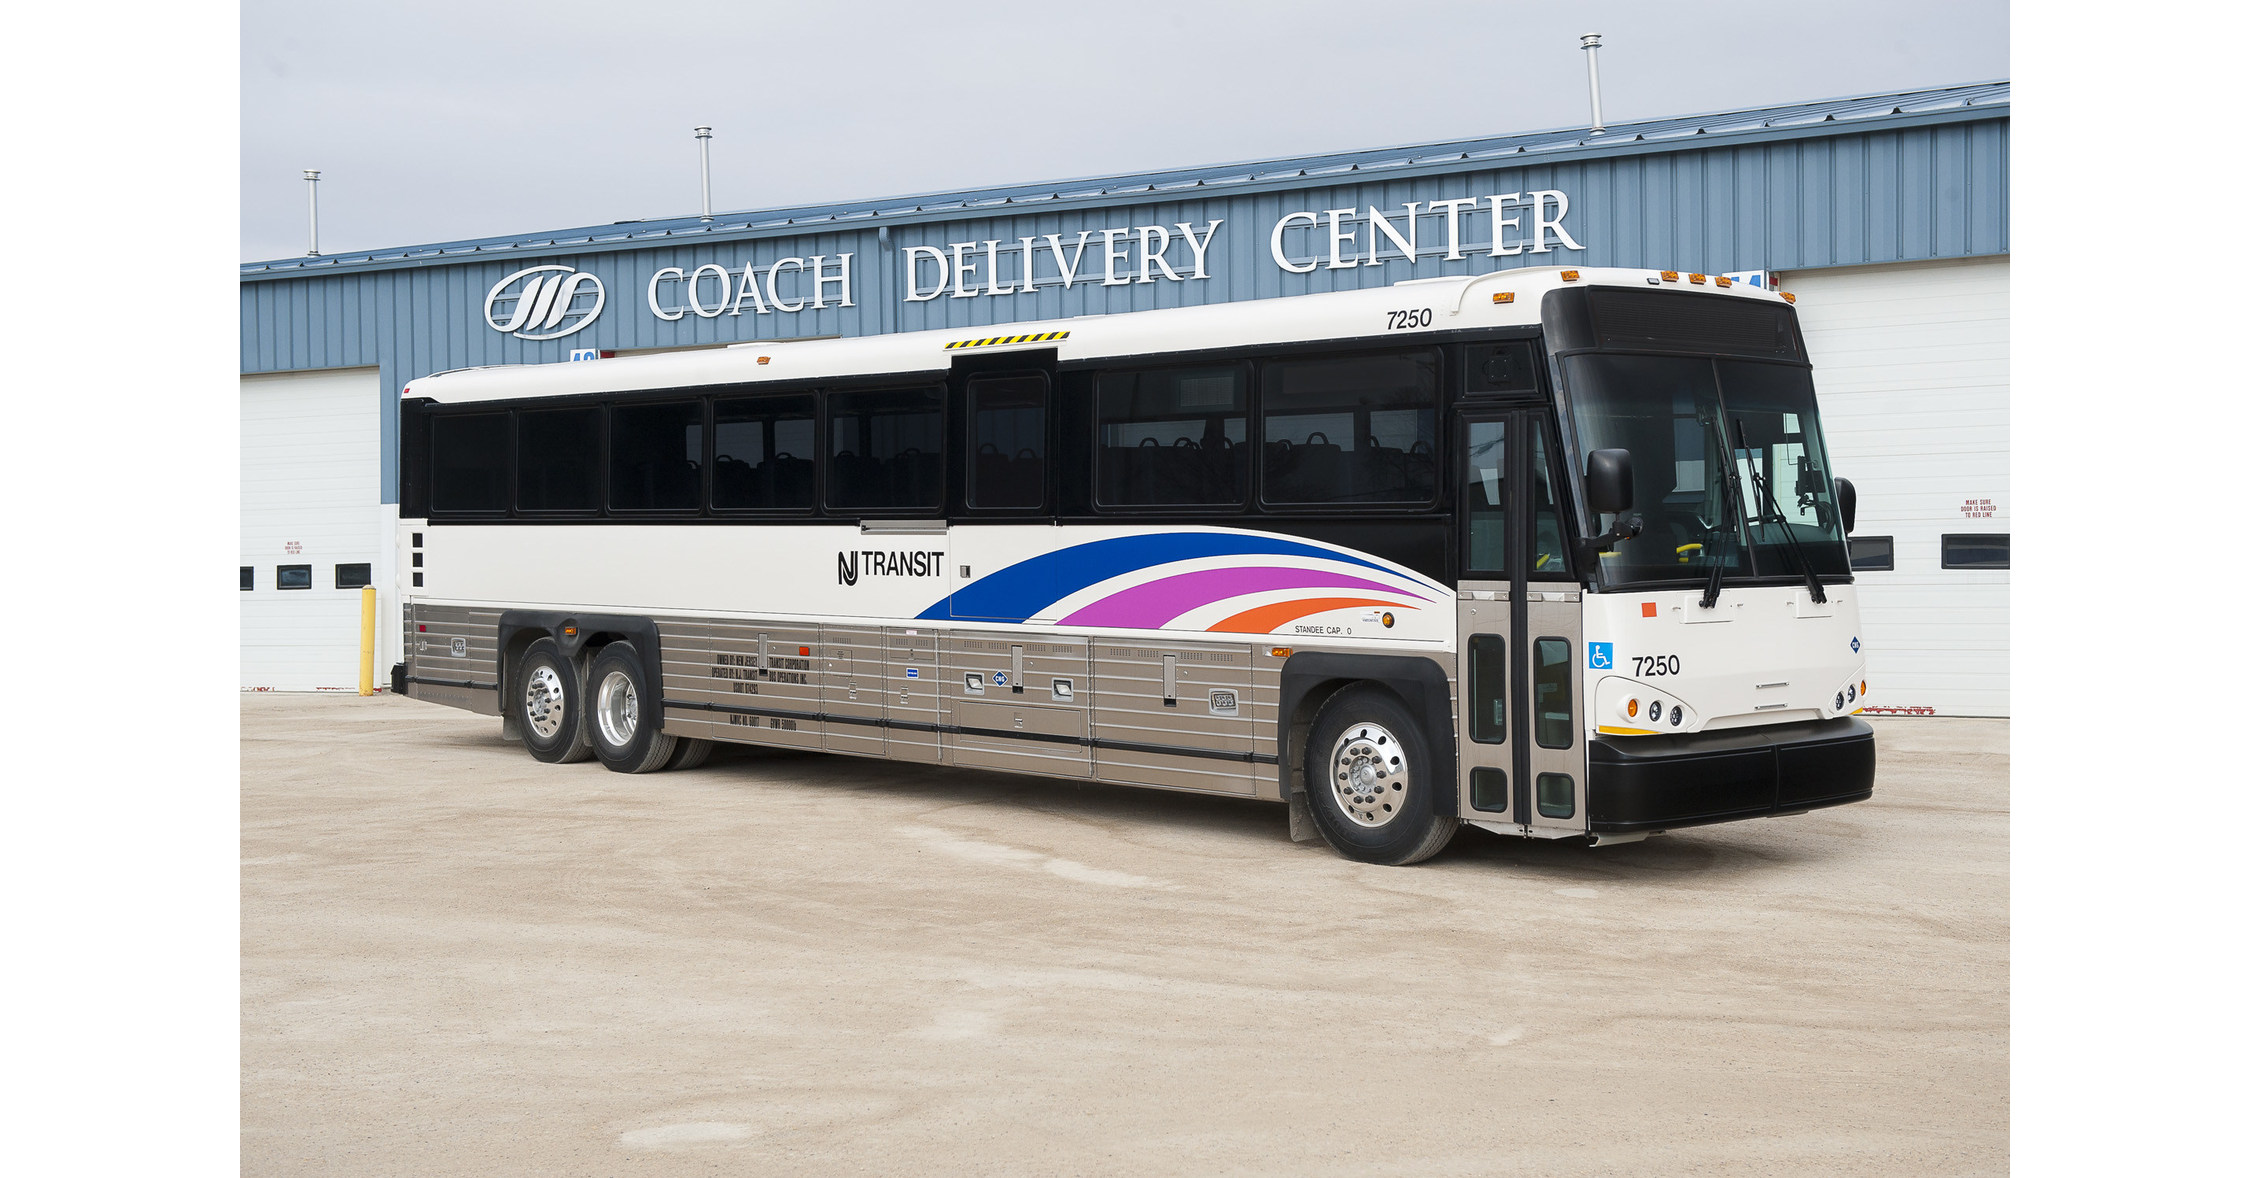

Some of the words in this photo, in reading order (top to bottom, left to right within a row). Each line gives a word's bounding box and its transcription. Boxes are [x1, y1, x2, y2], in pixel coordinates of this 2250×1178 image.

[648, 253, 856, 321] COACH
[901, 219, 1224, 302] DELIVERY
[1270, 189, 1586, 274] CENTER
[1387, 308, 1432, 330] 7250
[838, 551, 858, 586] NJ
[862, 551, 944, 577] TRANSIT
[1295, 625, 1324, 634] STANDEE
[1326, 626, 1343, 635] CAP.
[1632, 654, 1680, 677] 7250
